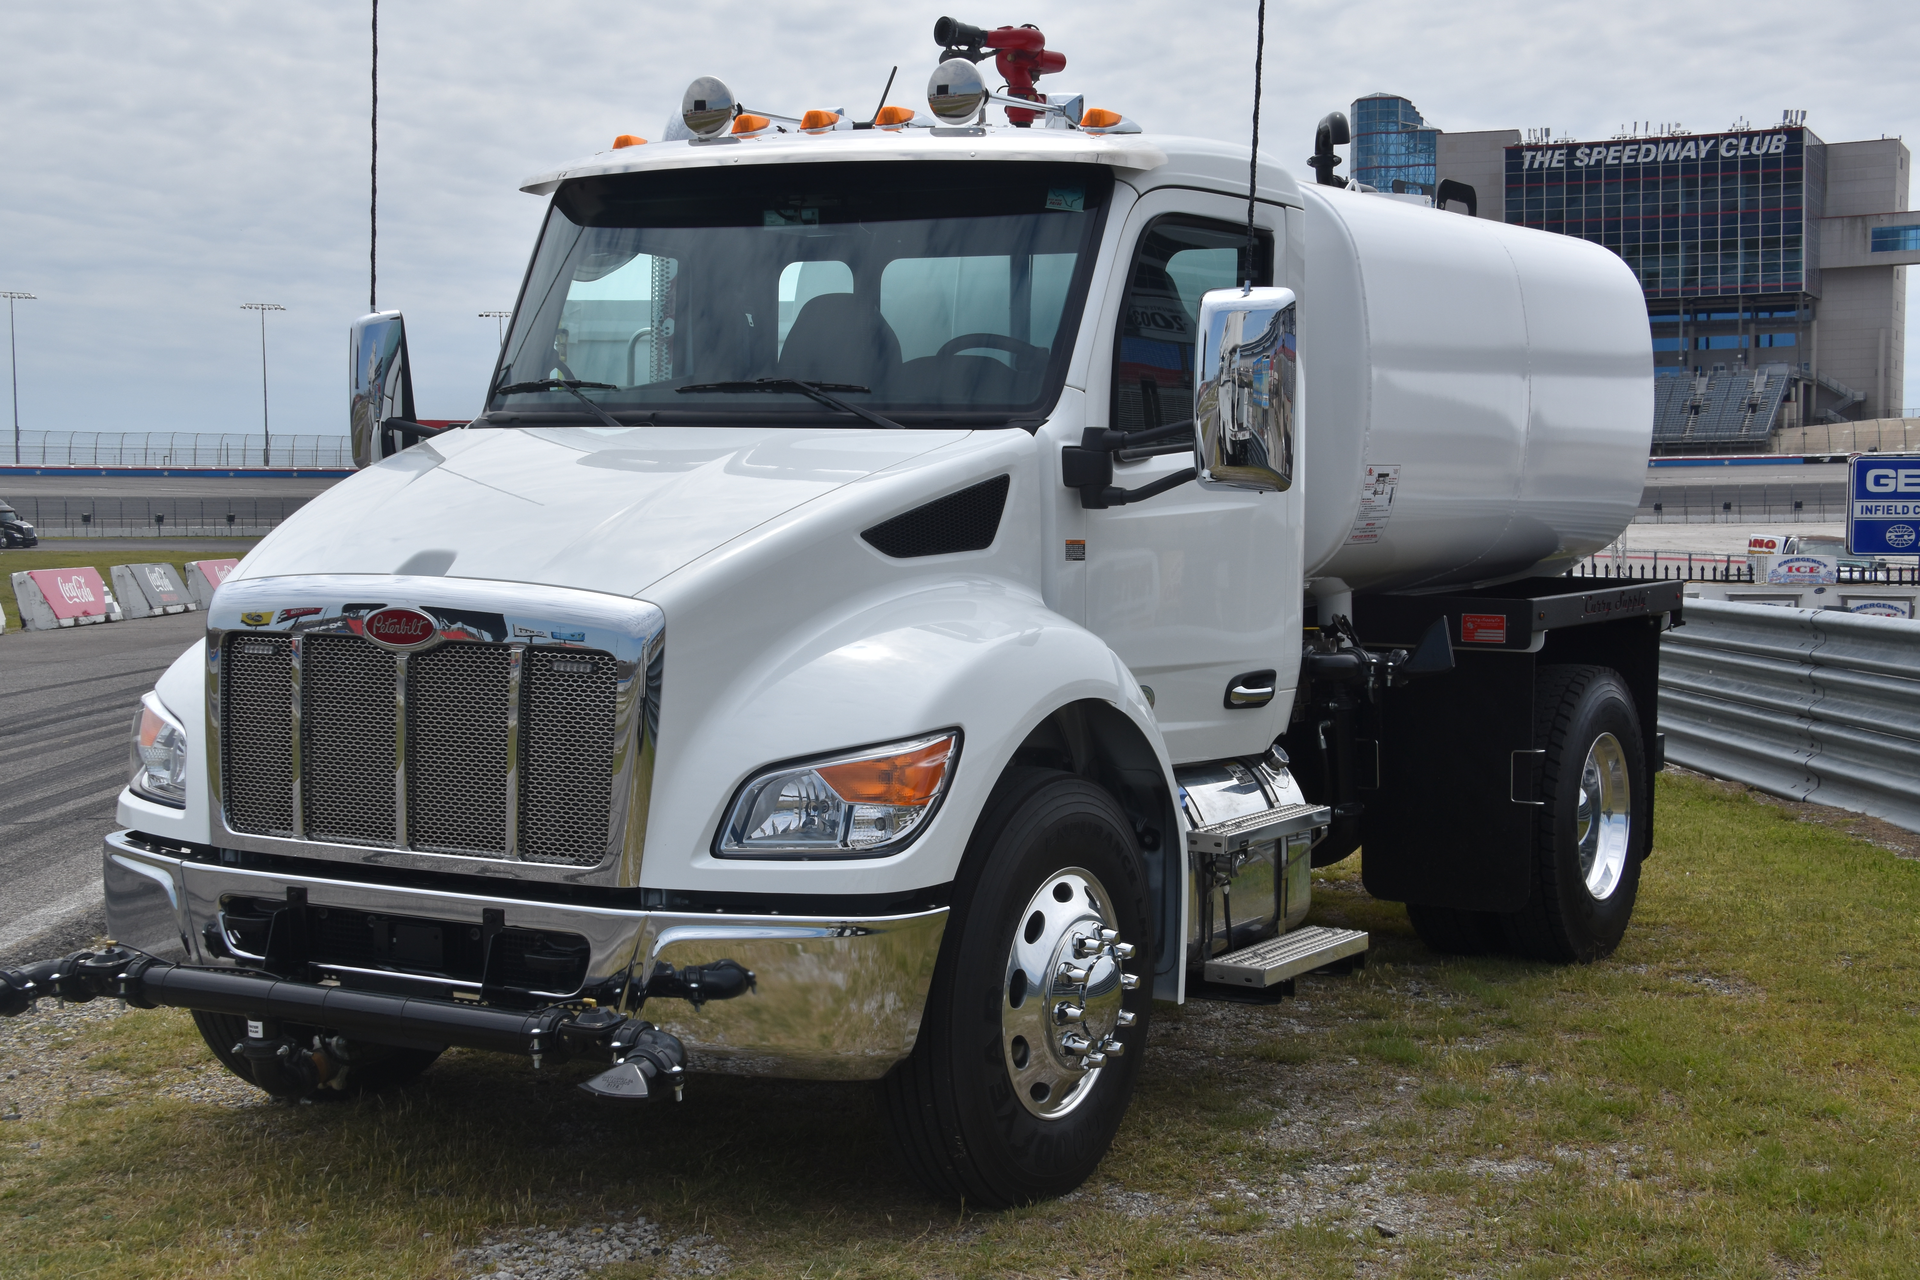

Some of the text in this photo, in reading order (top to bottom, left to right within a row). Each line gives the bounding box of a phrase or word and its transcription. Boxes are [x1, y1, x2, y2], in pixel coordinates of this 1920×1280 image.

[1521, 134, 1788, 169] THE SPEEDWAY CLUB
[1860, 504, 1910, 515] INFIELD
[1777, 557, 1828, 569] EMERGENCY
[1786, 565, 1821, 574] ICE
[1585, 591, 1646, 617] Curry Supply
[1850, 602, 1907, 616] EMERGENCY
[373, 614, 428, 635] Peterbilt
[1045, 820, 1138, 887] ENDURANCE
